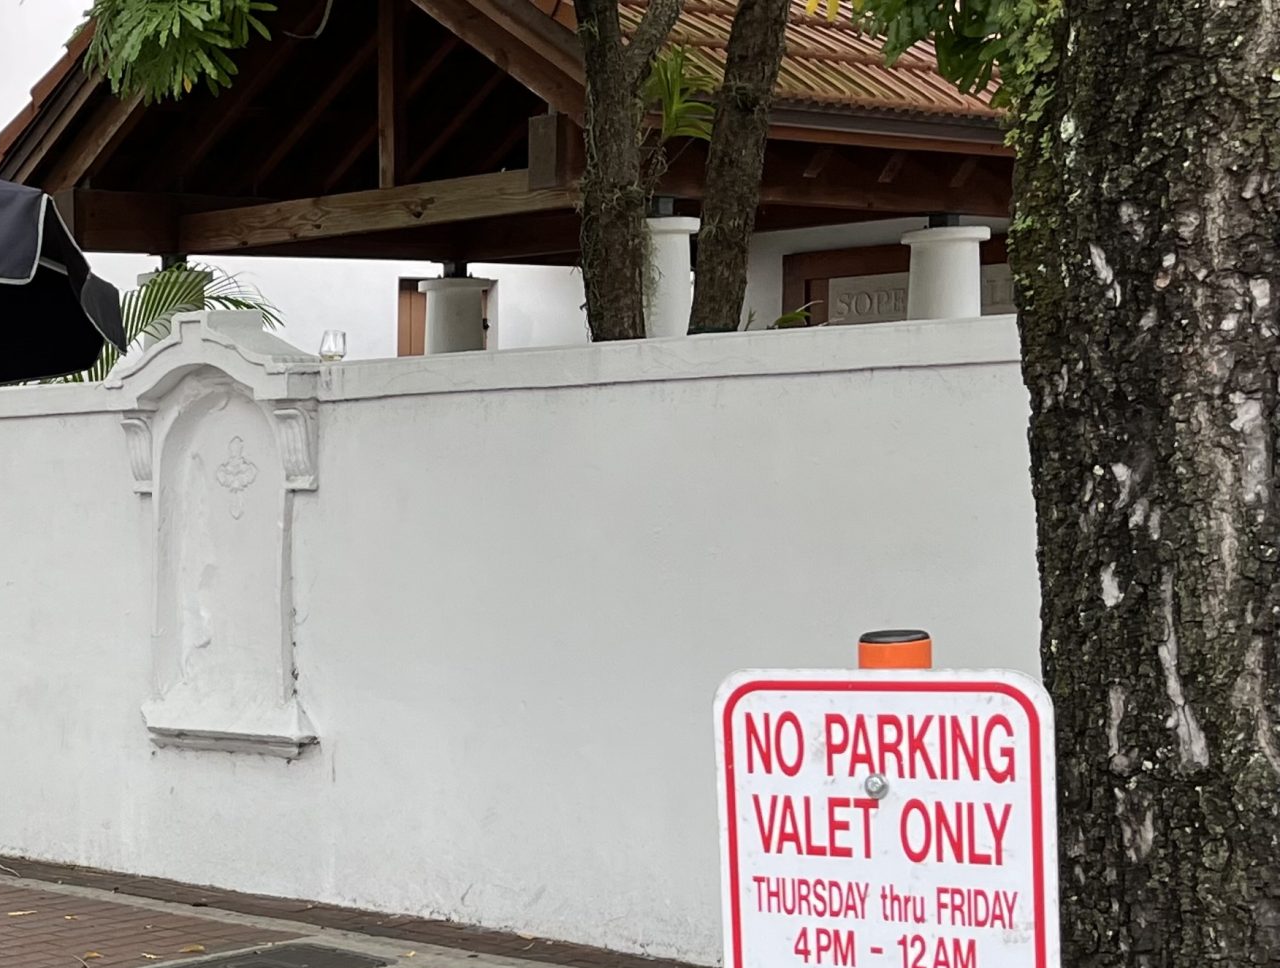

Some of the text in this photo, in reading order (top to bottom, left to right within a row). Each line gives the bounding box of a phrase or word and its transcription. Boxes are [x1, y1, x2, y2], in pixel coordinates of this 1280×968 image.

[745, 711, 1016, 784] NO PARKING
[752, 794, 1012, 866] VALET ONLY
[752, 876, 1018, 930] THURSDAY thru FRIDAY
